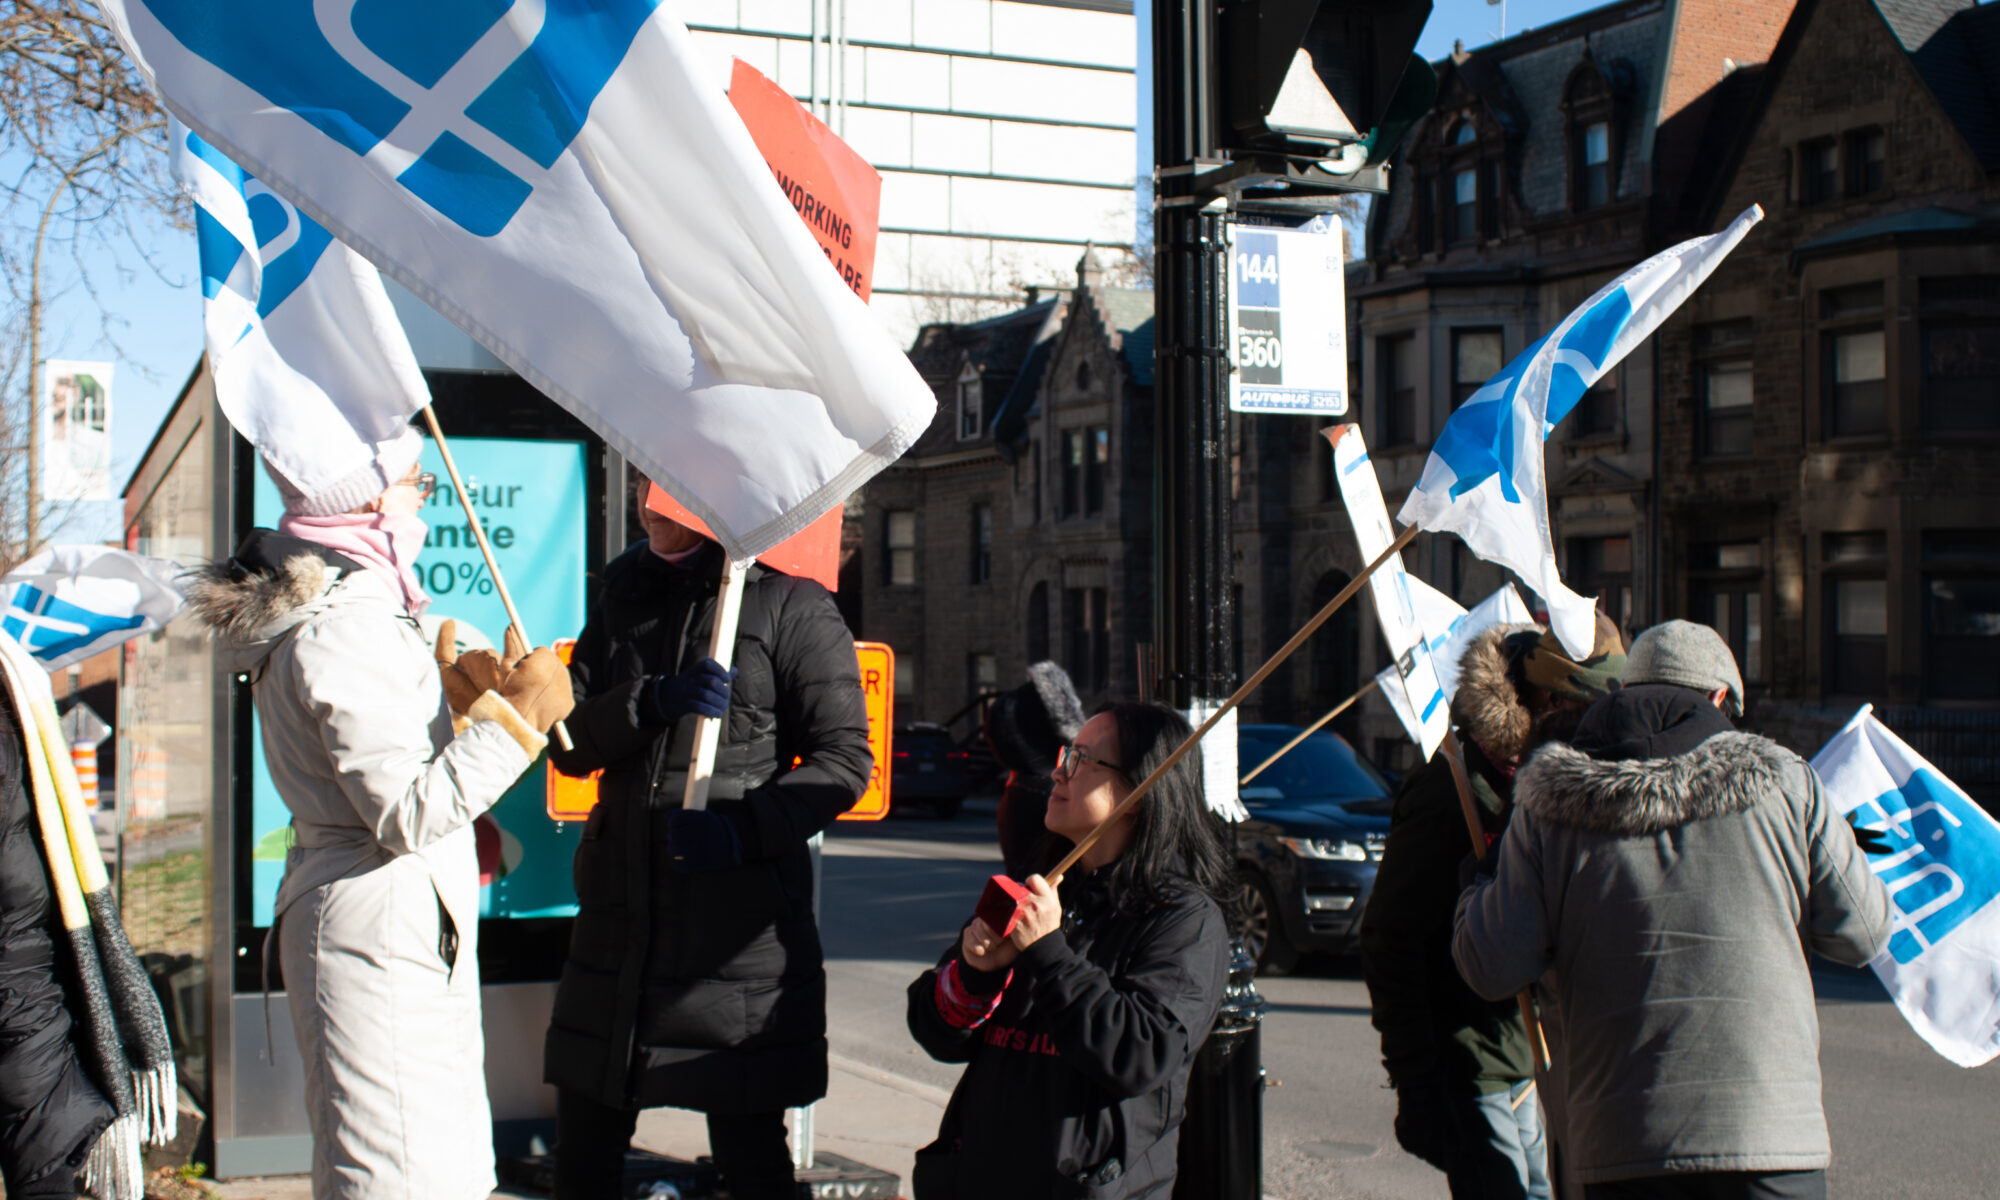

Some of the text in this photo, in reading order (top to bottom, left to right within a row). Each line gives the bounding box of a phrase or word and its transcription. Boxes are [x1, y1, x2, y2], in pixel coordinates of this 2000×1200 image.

[777, 170, 852, 249] WORKING
[1237, 253, 1278, 285] 144
[1240, 336, 1281, 368] 360
[1241, 391, 1311, 405] AUTOBUS
